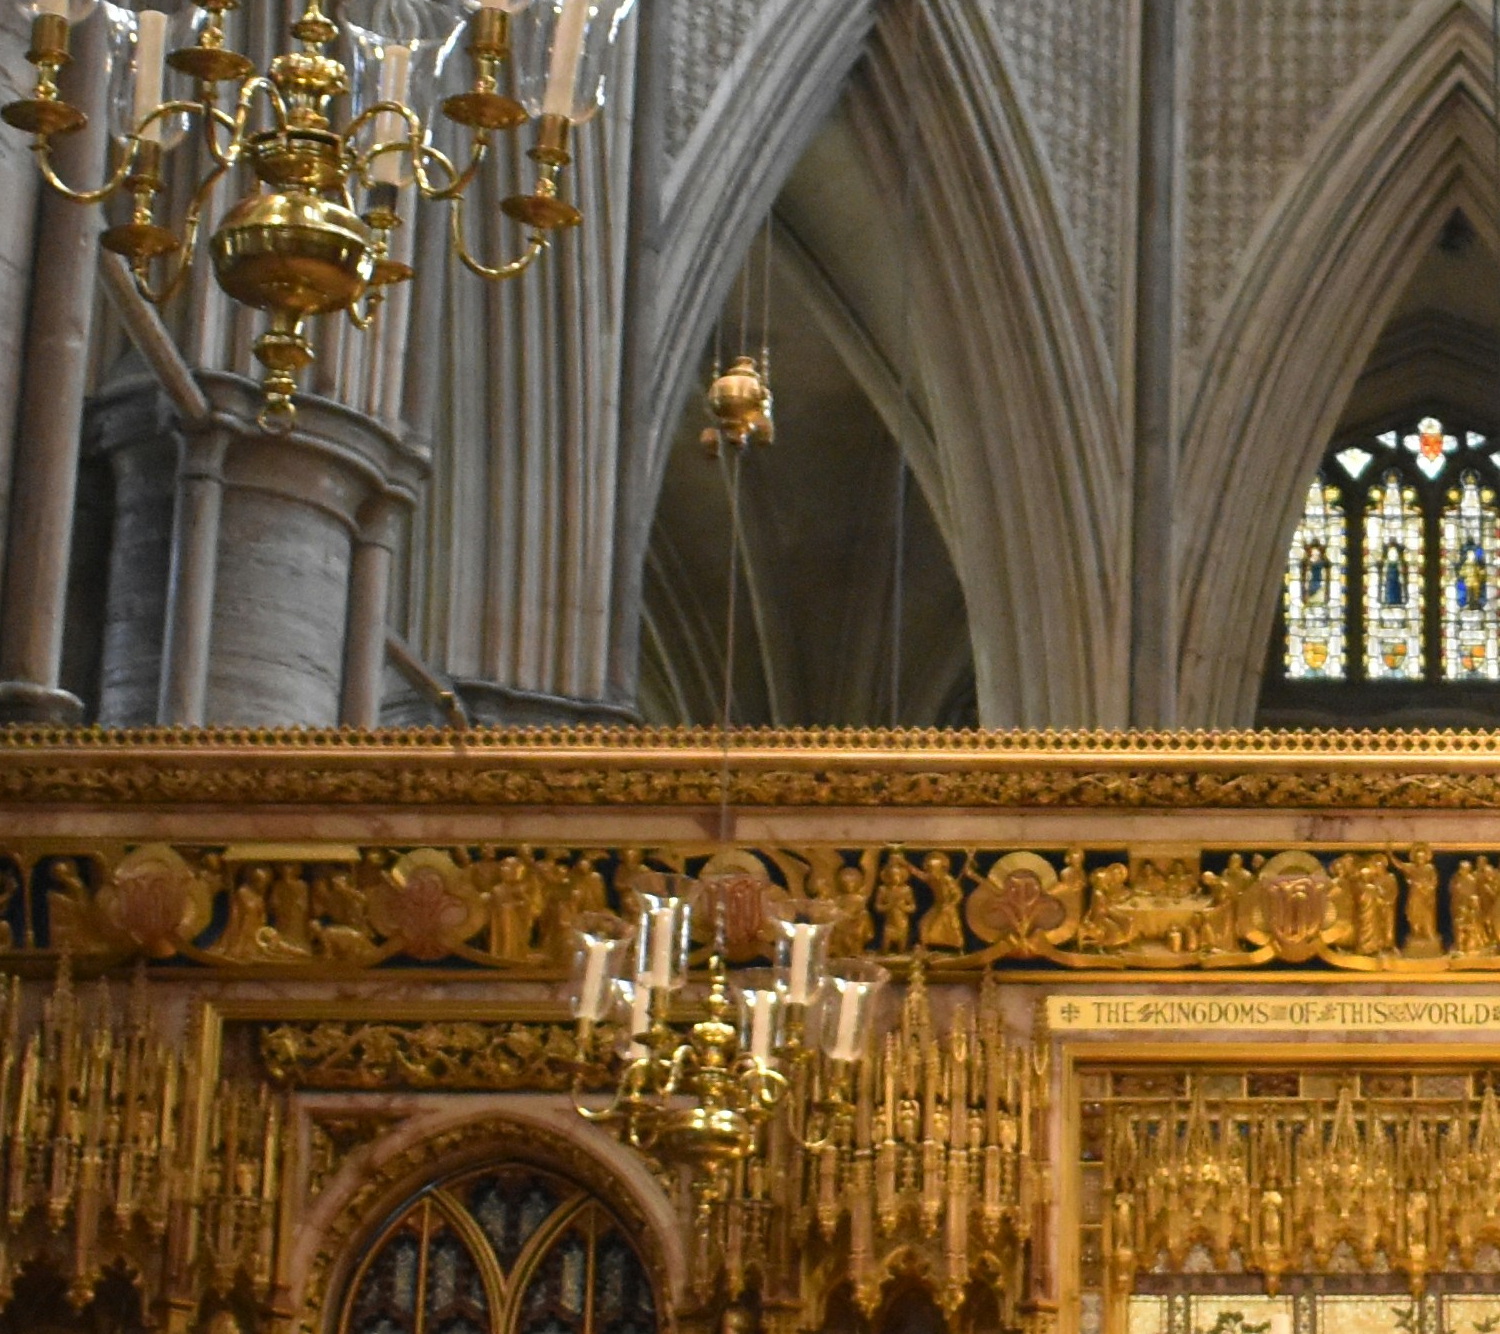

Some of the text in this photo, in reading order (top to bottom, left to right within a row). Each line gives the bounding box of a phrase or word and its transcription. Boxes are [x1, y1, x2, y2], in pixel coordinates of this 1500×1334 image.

[1092, 1001, 1136, 1024] THE
[1153, 1001, 1269, 1024] KINGDOMS
[1289, 1001, 1319, 1024] OF
[1336, 1001, 1388, 1024] THIS
[1405, 1001, 1491, 1024] WORLD
